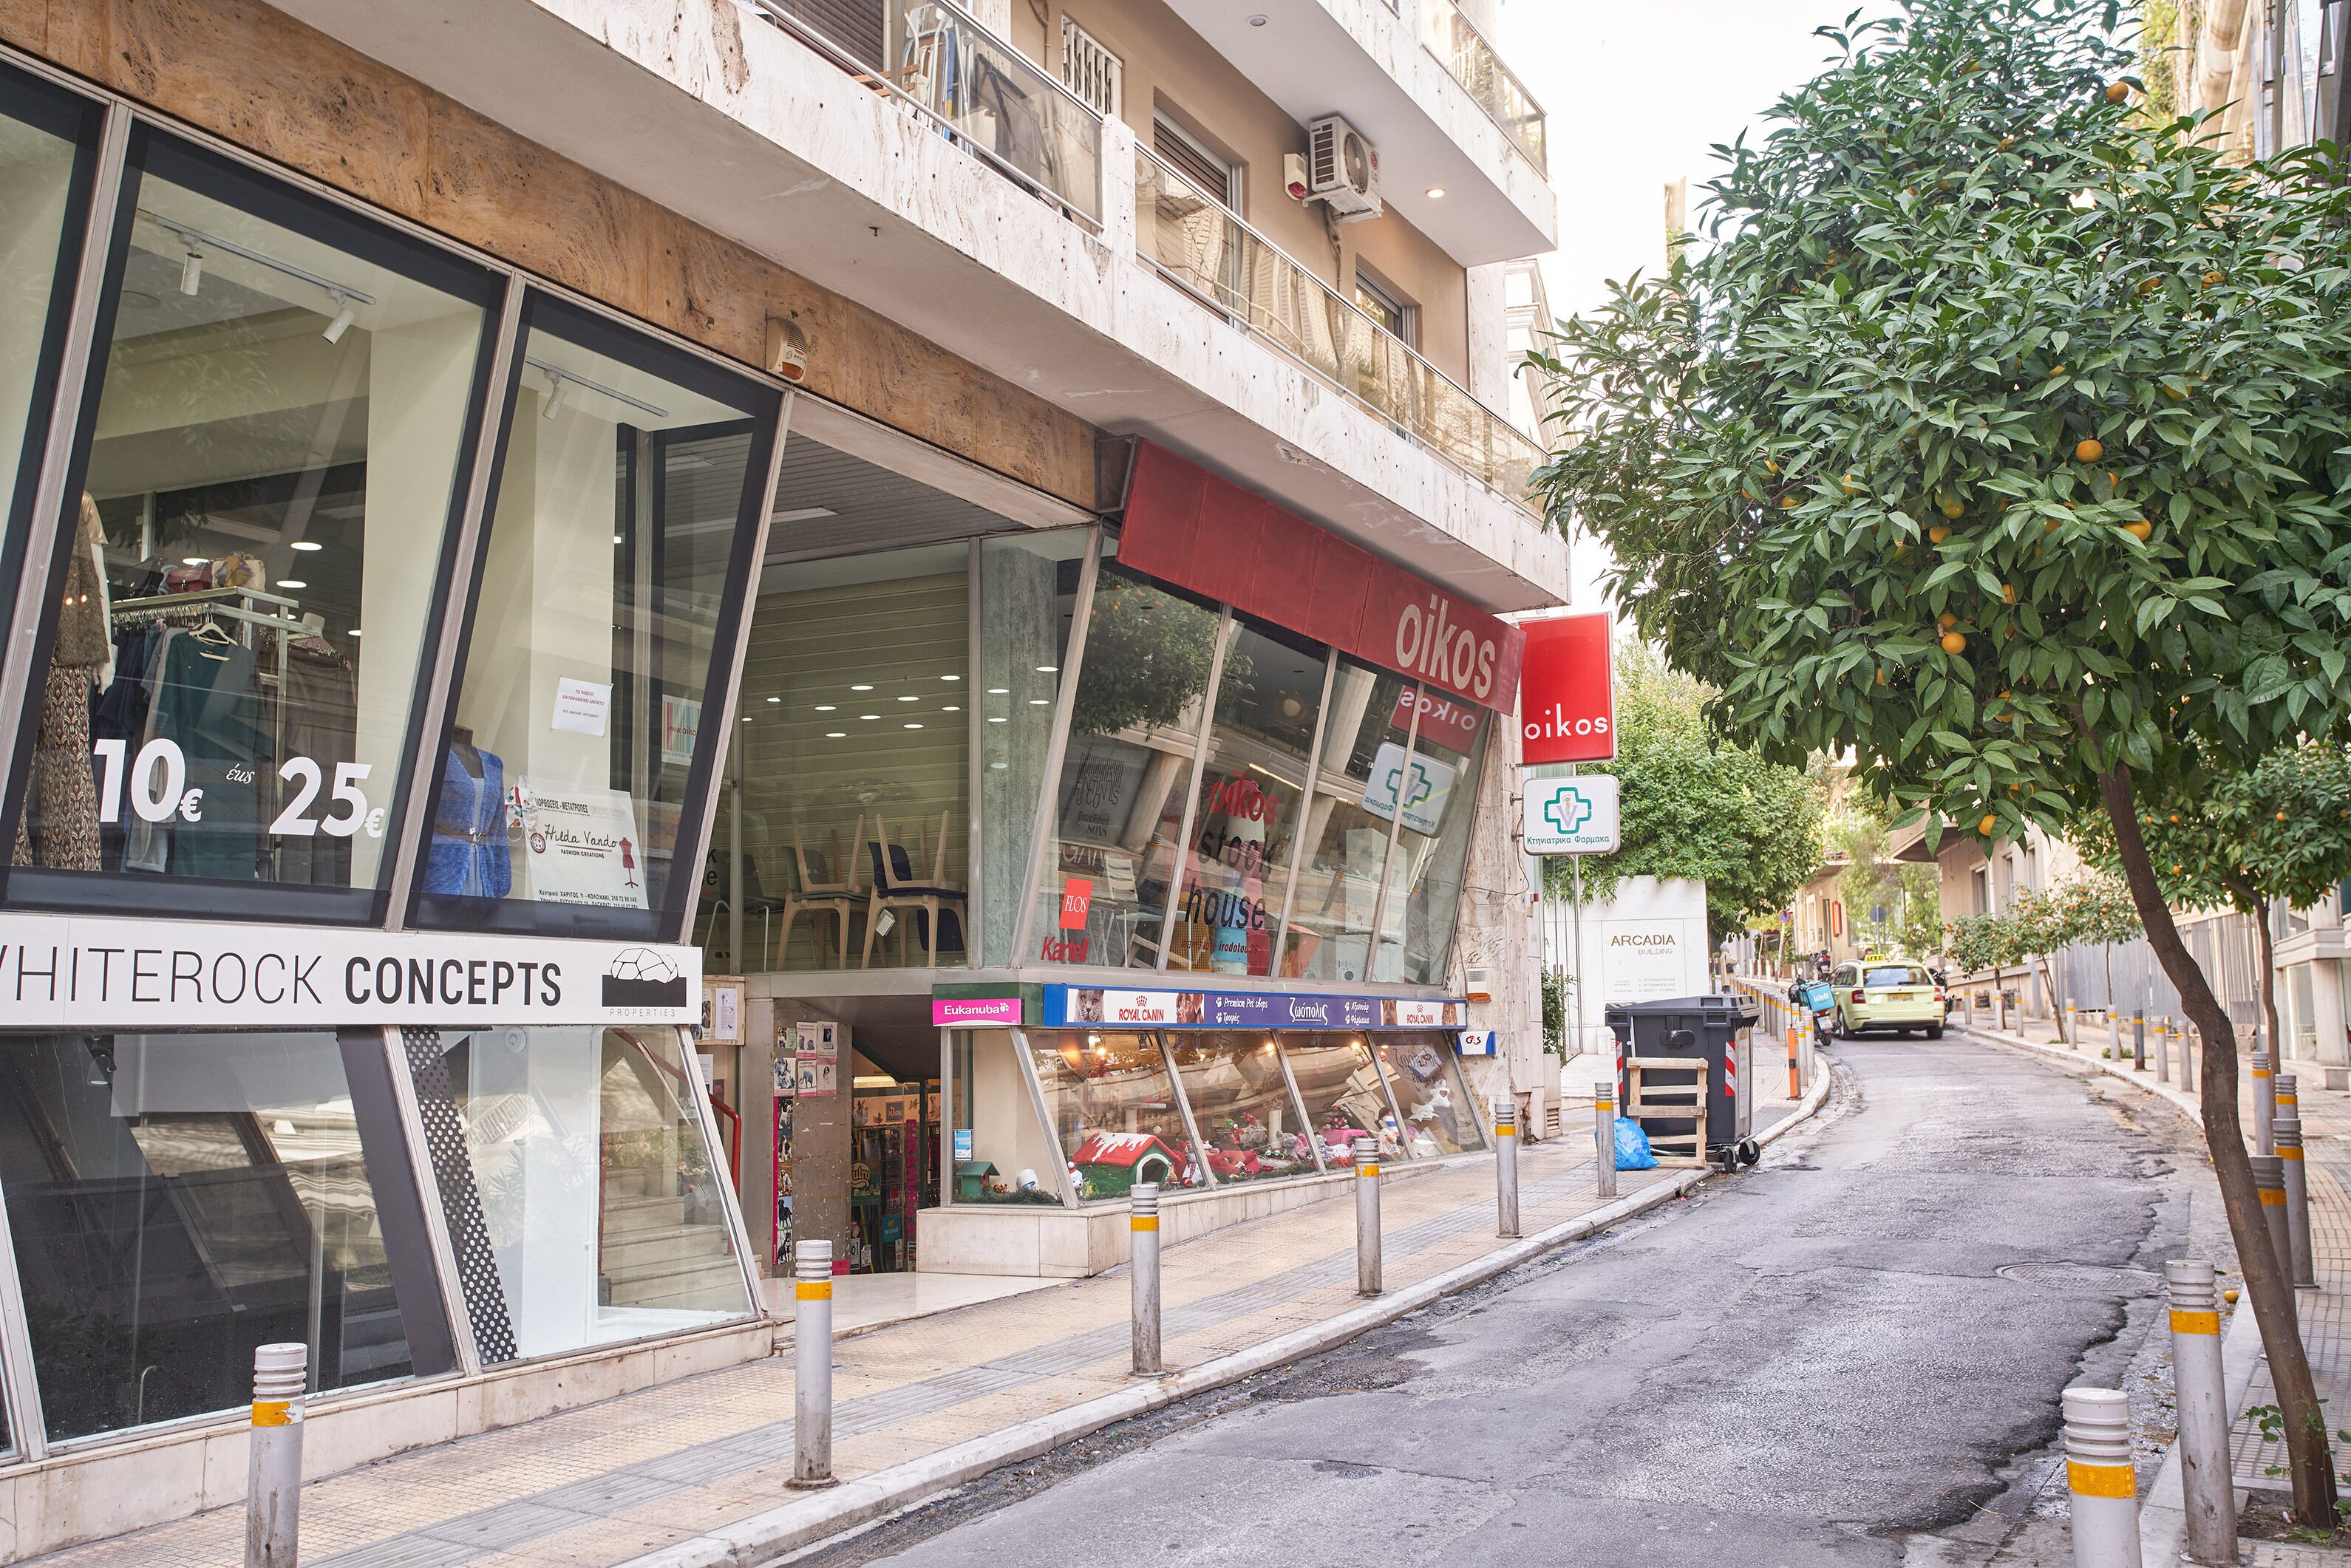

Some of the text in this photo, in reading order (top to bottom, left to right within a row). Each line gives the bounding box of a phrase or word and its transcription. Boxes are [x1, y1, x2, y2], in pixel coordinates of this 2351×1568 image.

[1396, 593, 1495, 698] oikos
[1524, 703, 1608, 740] oikos
[94, 737, 204, 823] 10€
[269, 757, 386, 838] 25€
[1209, 768, 1278, 825] oikos
[562, 801, 589, 814] ΜΕΤΑΤΡΟΠΕΣ
[1078, 811, 1109, 825] Established
[545, 823, 618, 848] Hilda Vando
[1086, 825, 1108, 837] SONS
[1527, 835, 1610, 845] Κτηνιατρικα Φαρμακα
[560, 848, 580, 856] FASHION
[1198, 825, 1276, 874] stock
[1064, 895, 1087, 913] FLOS
[1185, 878, 1266, 930] house
[1611, 934, 1675, 946] ARCADIA
[1041, 935, 1089, 963] Kartell
[1219, 941, 1248, 953] irodotou
[0, 944, 561, 1006] HITEROCK CONCEPTS
[1814, 992, 1829, 1002] Wolt
[945, 1005, 999, 1015] Eukanuba
[1224, 998, 1268, 1011] Premium Pet shops
[609, 1008, 676, 1017] PROPERTIES
[1119, 1008, 1164, 1021] ROYAL CANIN
[1289, 998, 1329, 1025] ζωόπολις
[1406, 1014, 1434, 1024] ROYAL CANIN
[1466, 1035, 1481, 1045] G4S
